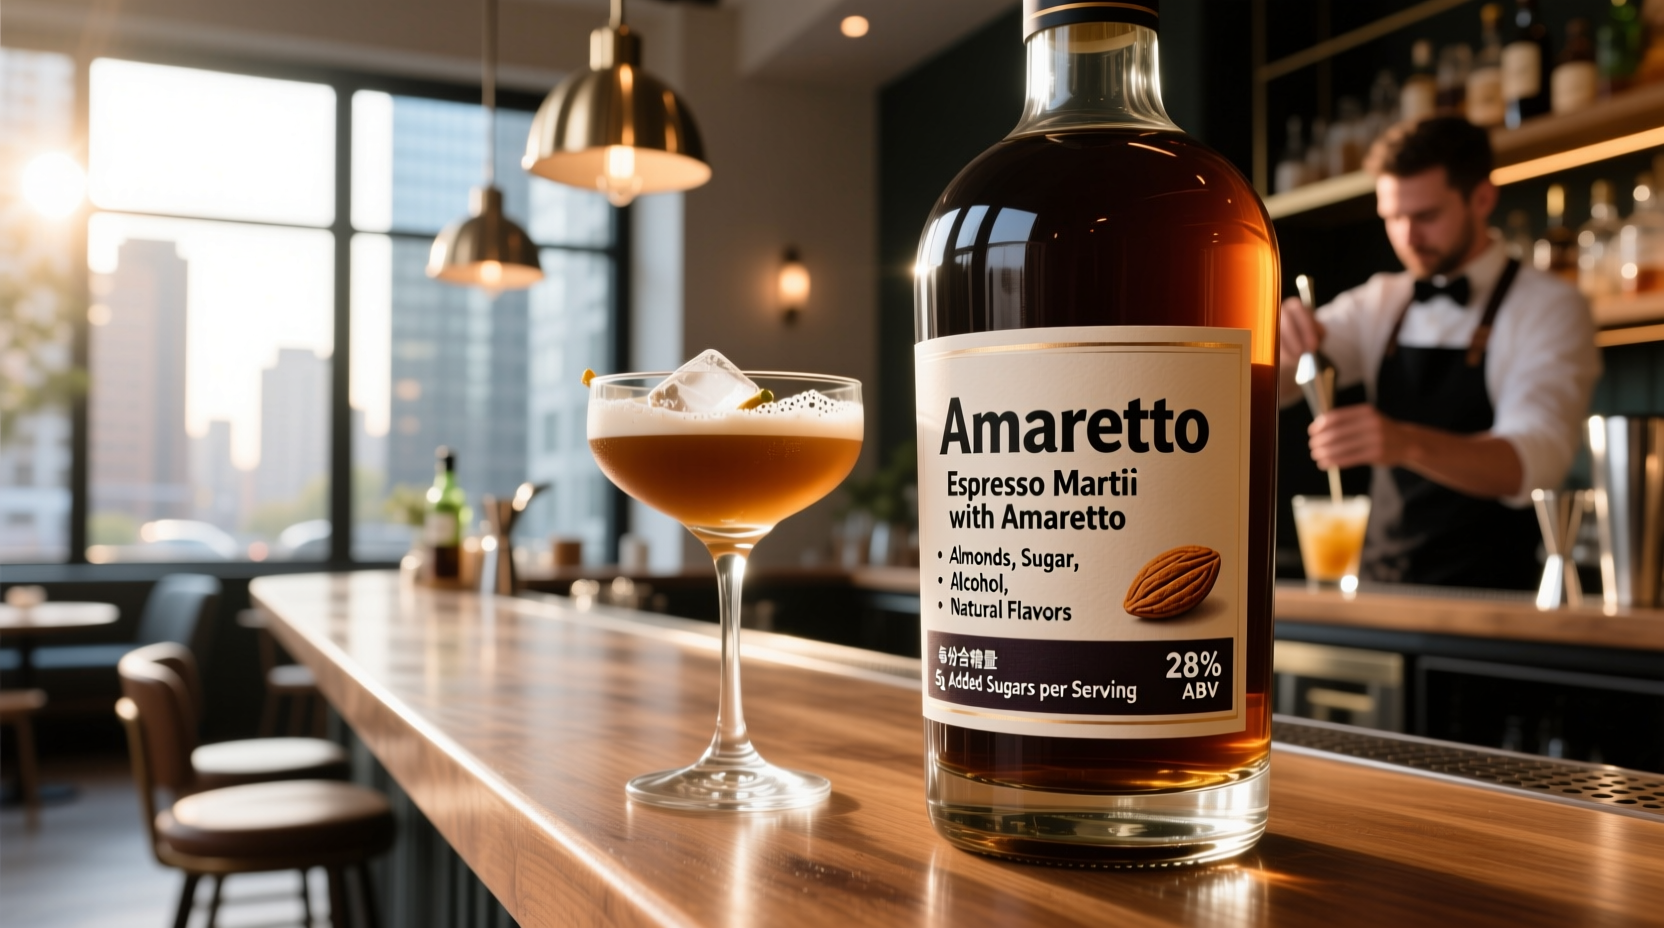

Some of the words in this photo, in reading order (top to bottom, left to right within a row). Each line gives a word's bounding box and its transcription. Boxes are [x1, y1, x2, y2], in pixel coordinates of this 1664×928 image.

[939, 397, 1209, 455] Amaretto
[947, 470, 1045, 501] Espresso
[1053, 467, 1138, 497] Martii
[949, 503, 994, 529] with
[1001, 504, 1126, 530] Amaretto
[949, 544, 1016, 571] Almonds,
[1021, 548, 1079, 573] Sugar,
[950, 571, 1008, 596] Alcohol,
[950, 597, 1002, 619] Natural
[1007, 600, 1072, 621] Flavors
[1166, 650, 1222, 679] 28%
[948, 671, 983, 691] Added
[987, 675, 1035, 699] Sugars
[1039, 683, 1068, 702] per
[1071, 680, 1137, 704] Serving
[1182, 681, 1219, 700] ABV
